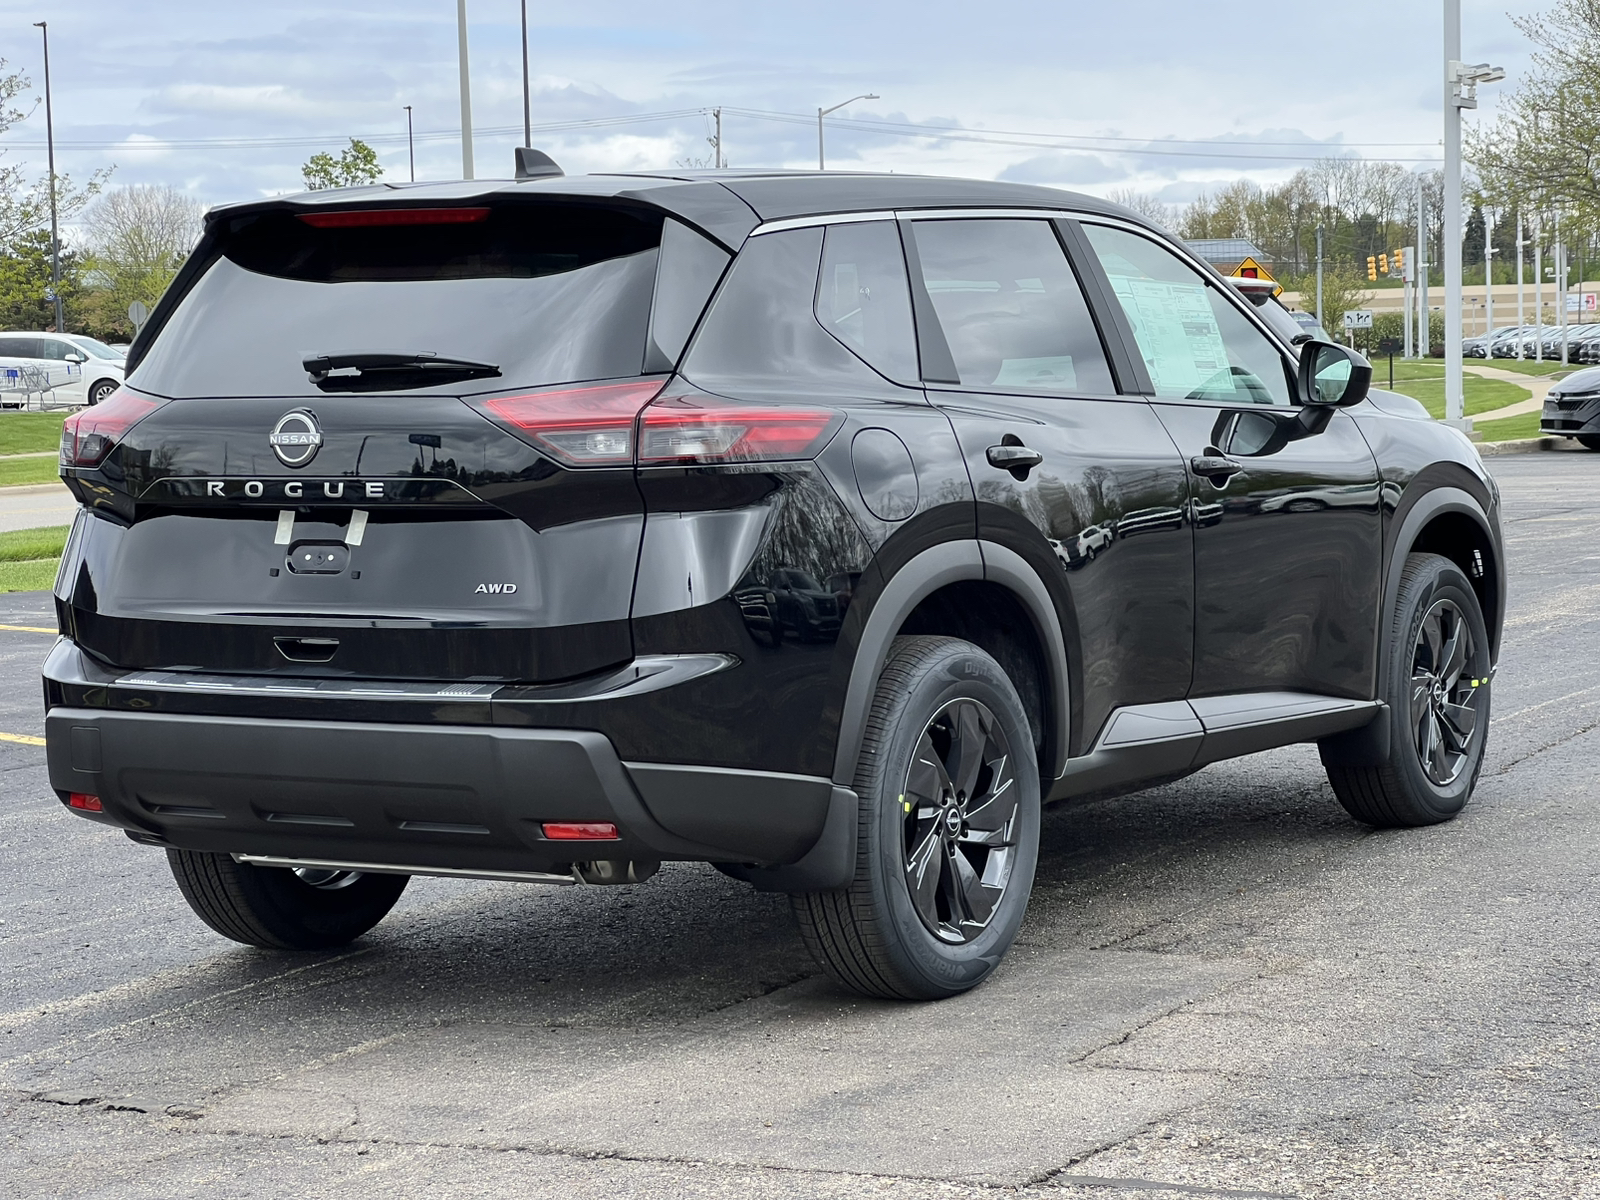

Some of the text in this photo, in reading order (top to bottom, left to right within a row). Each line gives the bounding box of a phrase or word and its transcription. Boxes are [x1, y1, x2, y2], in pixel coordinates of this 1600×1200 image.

[270, 435, 320, 445] NISSAN
[207, 481, 385, 498] ROGUE
[474, 583, 517, 594] AWD
